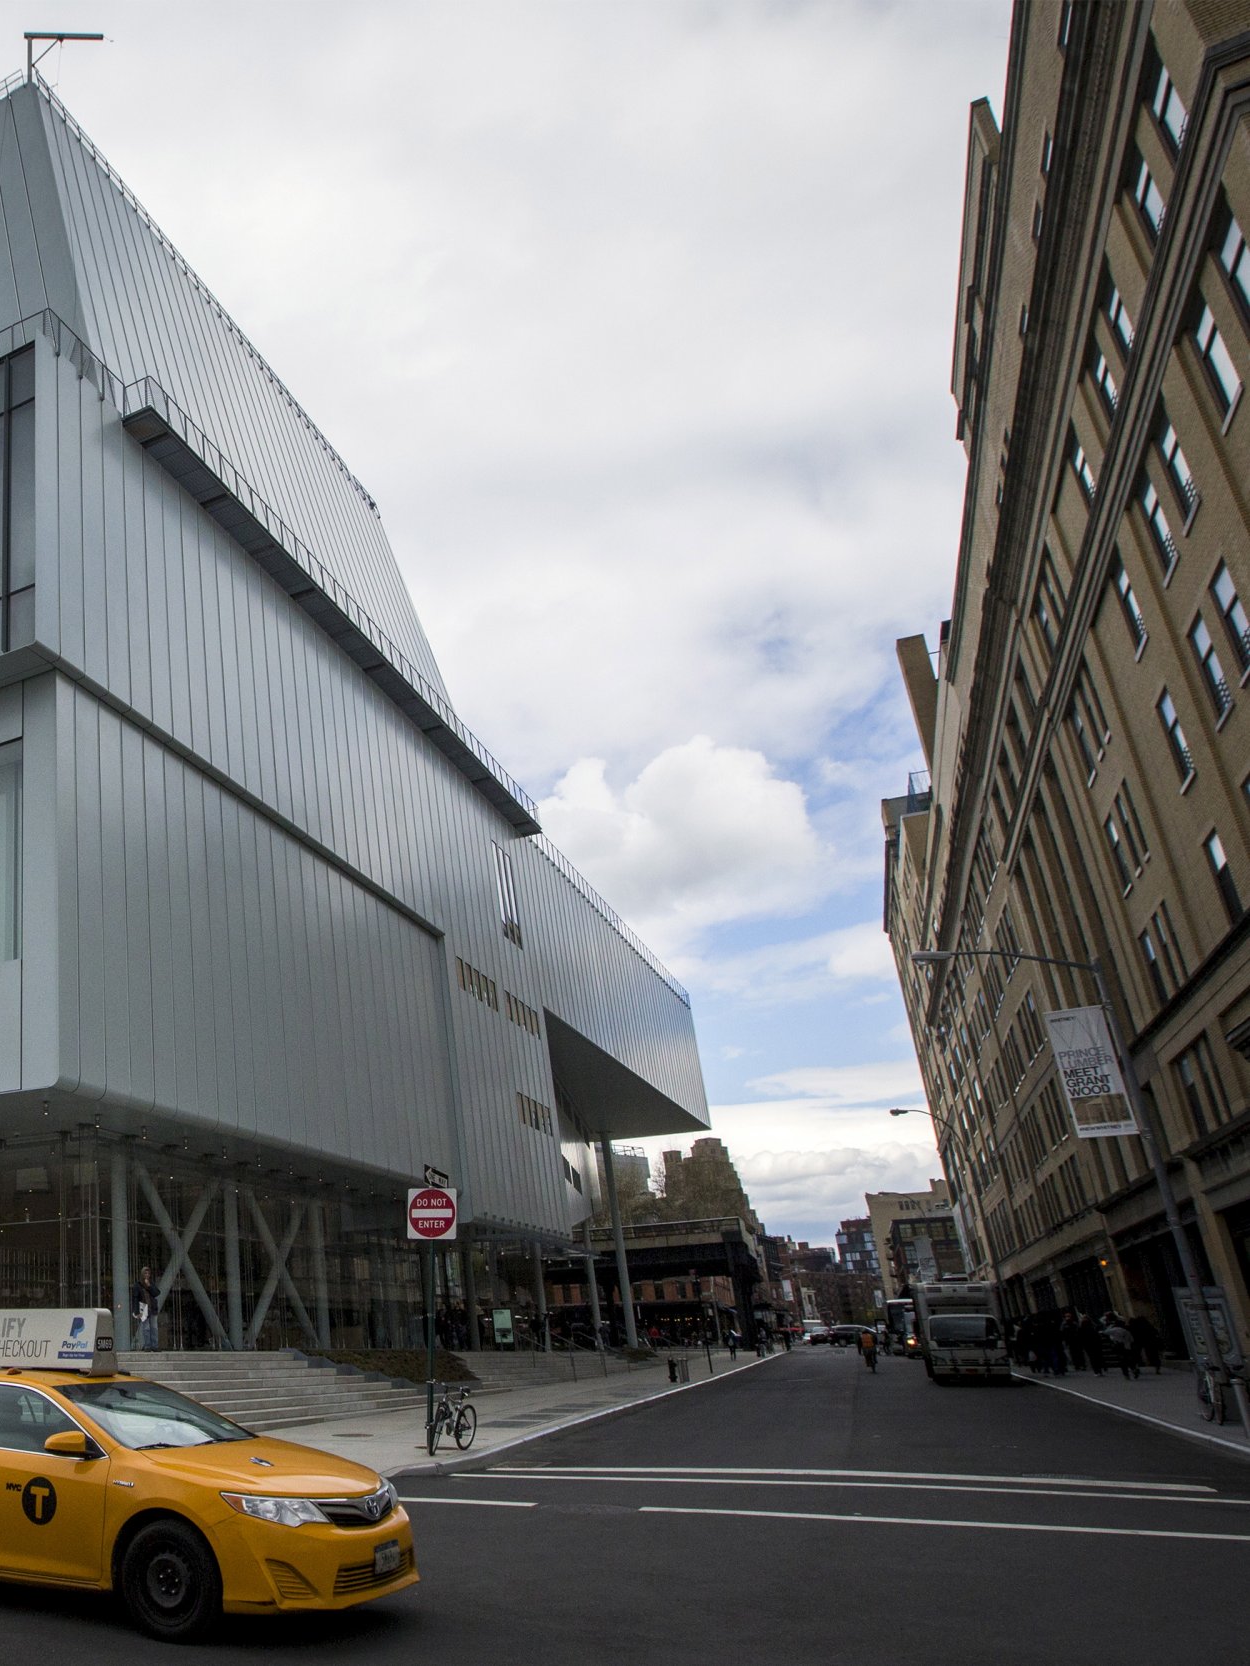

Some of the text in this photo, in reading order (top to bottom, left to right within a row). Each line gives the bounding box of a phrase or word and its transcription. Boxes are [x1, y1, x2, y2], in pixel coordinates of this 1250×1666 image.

[1058, 1046, 1104, 1060] PRINCE
[1060, 1055, 1114, 1070] LUMBER
[1063, 1066, 1100, 1079] MEET
[1066, 1074, 1111, 1088] GRANT
[1067, 1085, 1111, 1097] WOOD
[416, 1198, 447, 1207] DO NOT
[418, 1220, 445, 1229] ENTER
[62, 1340, 88, 1350] PayPal
[6, 1482, 22, 1491] NYC
[30, 1485, 50, 1519] T
